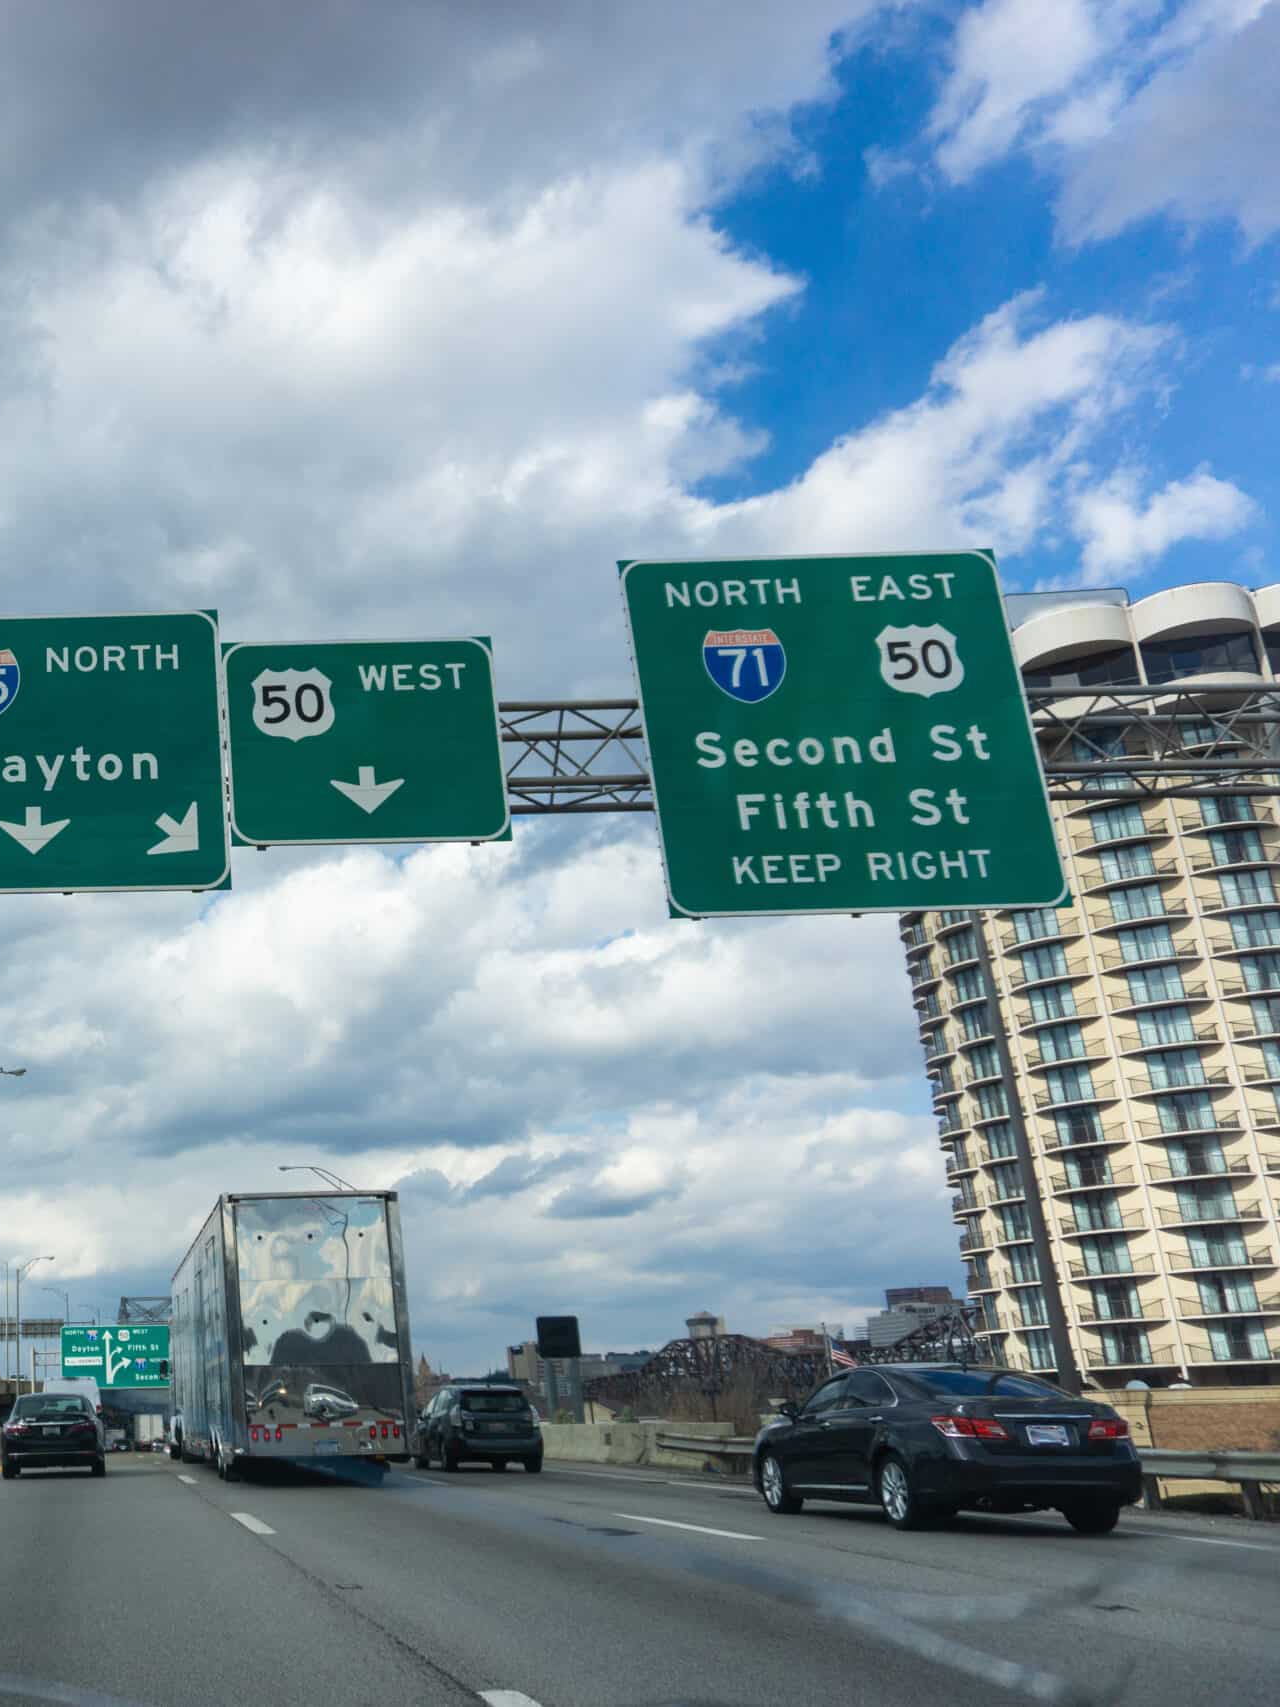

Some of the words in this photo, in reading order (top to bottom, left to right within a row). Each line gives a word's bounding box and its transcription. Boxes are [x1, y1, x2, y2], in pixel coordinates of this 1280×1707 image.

[665, 578, 801, 608] NORTH
[850, 573, 955, 602] EAST
[46, 644, 179, 673] NORTH
[717, 648, 769, 688] 71
[886, 639, 953, 681] 50
[358, 663, 466, 691] WEST
[261, 683, 325, 724] 50
[695, 727, 897, 768] Second
[930, 724, 991, 761] St
[736, 792, 875, 831] Fifth
[909, 788, 970, 826] St
[732, 853, 841, 885] KEEP
[866, 849, 991, 881] RIGHT
[127, 1343, 147, 1351] Fifth
[150, 1343, 160, 1351] St
[135, 1373, 161, 1381] Secon
